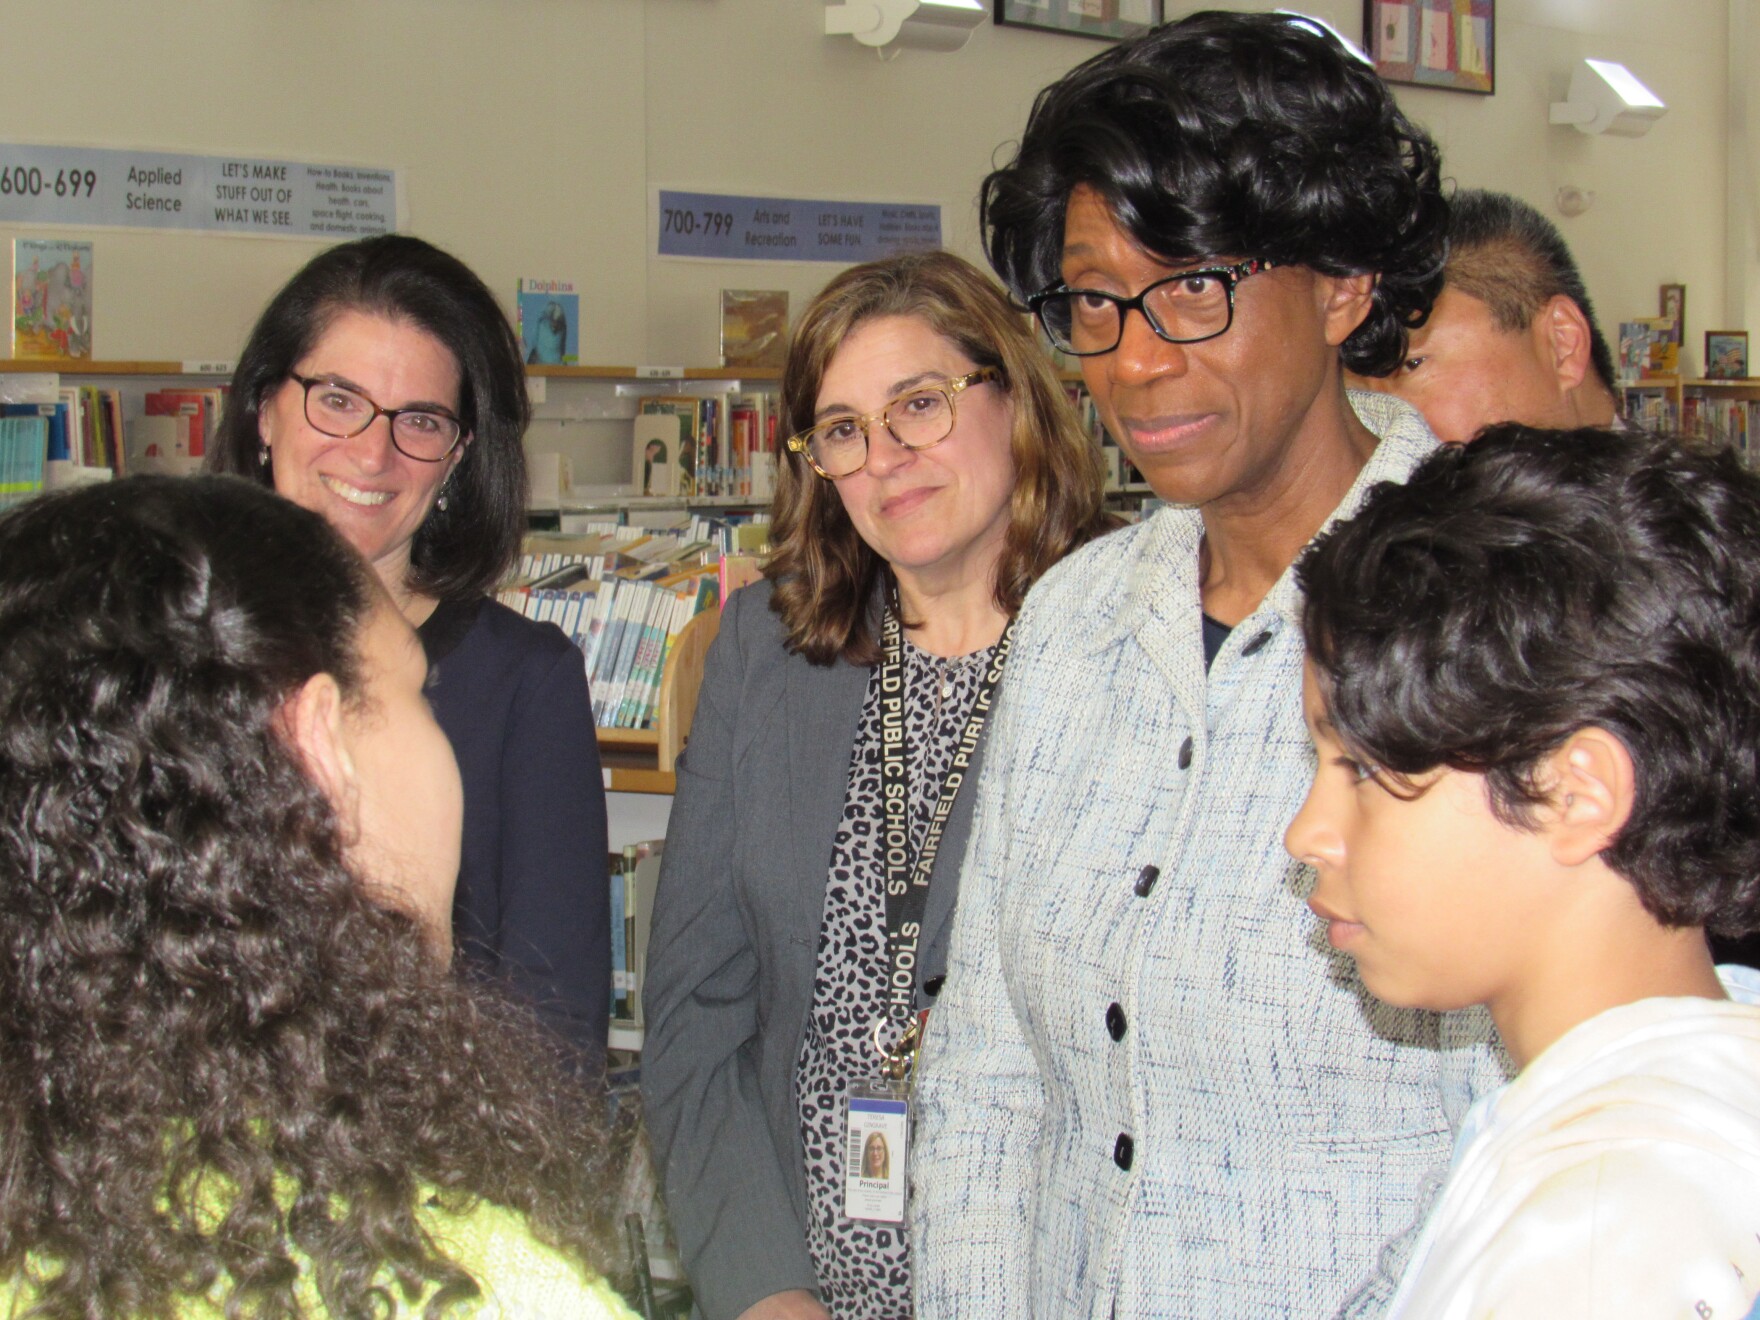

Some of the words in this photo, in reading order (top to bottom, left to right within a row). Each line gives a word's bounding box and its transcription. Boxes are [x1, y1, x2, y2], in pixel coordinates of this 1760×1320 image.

[127, 165, 182, 187] Applied
[222, 162, 249, 178] LET'S
[252, 165, 287, 181] MAKE
[1, 166, 96, 197] 600-699
[126, 192, 182, 212] Science
[216, 184, 247, 200] STUFF
[250, 186, 273, 202] OUT
[276, 188, 292, 203] OF
[214, 207, 249, 223] WHAT
[252, 209, 270, 225] WE
[664, 208, 734, 236] 700-799
[752, 208, 770, 225] Arts
[772, 210, 790, 225] and
[818, 213, 838, 227] LET'S
[840, 214, 863, 228] HAVE
[310, 222, 325, 232] and
[745, 230, 797, 247] Recreation
[818, 232, 841, 246] SOME
[528, 278, 574, 297] Dolphins
[882, 697, 905, 779] PUBLIC
[884, 782, 908, 896] SCHOOLS
[912, 772, 963, 887] FAIRFIELD
[859, 1179, 890, 1190] Principal
